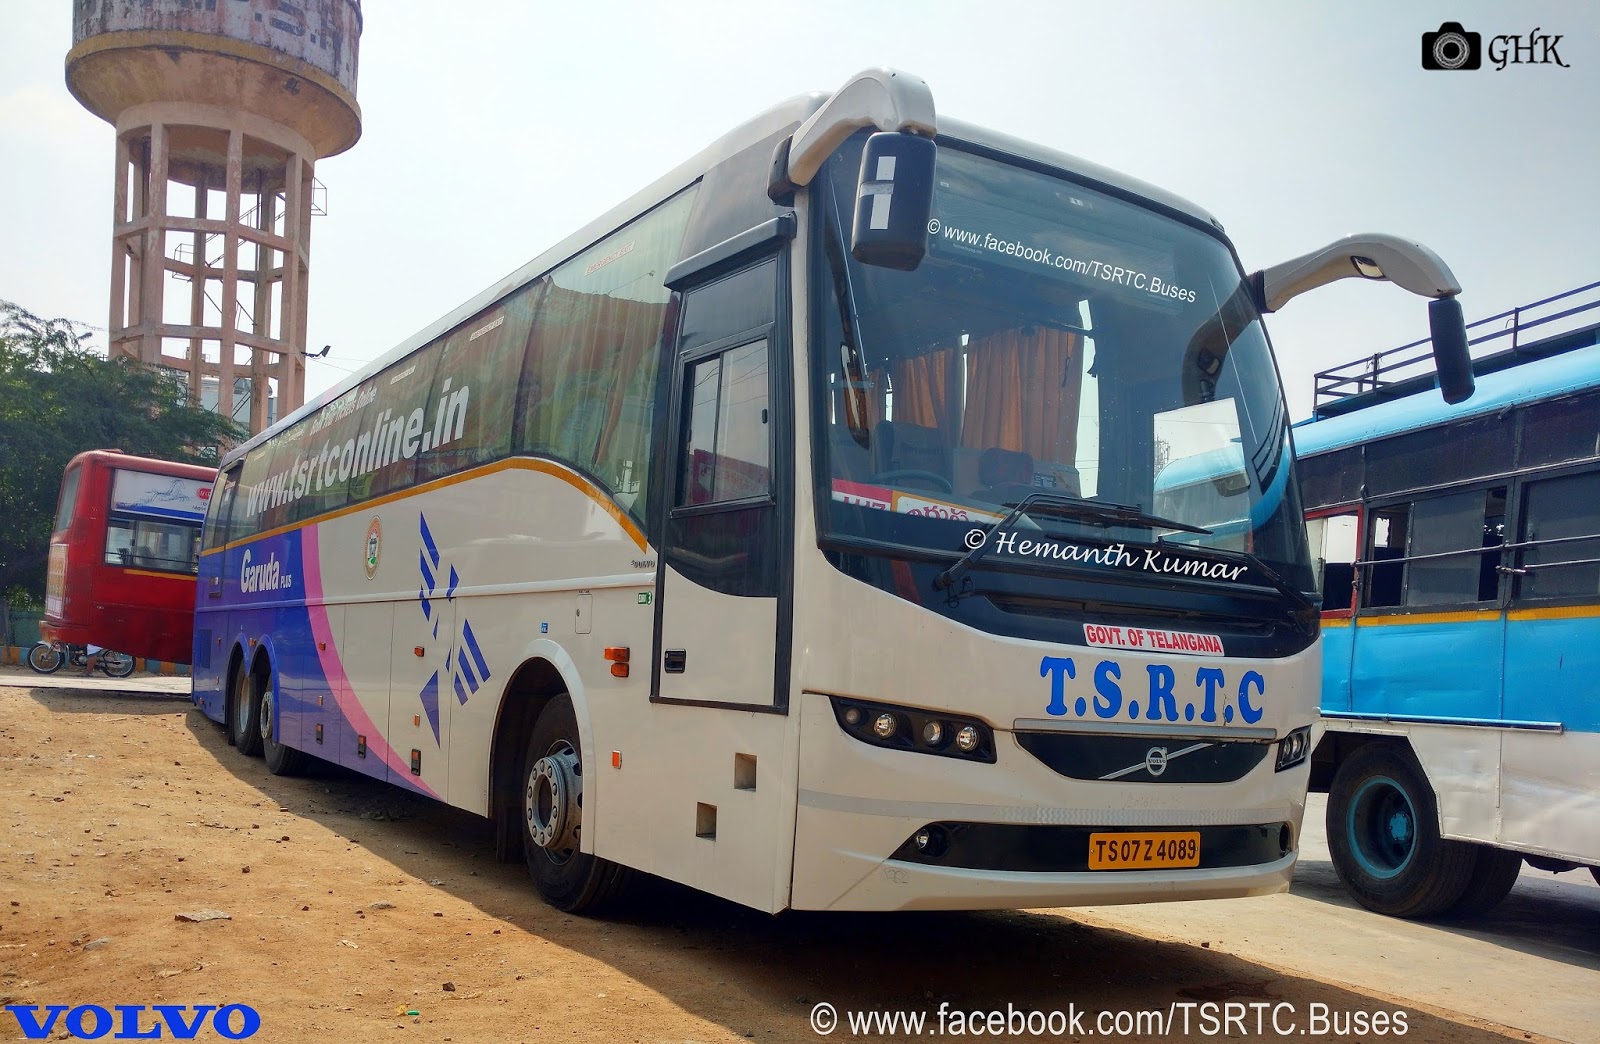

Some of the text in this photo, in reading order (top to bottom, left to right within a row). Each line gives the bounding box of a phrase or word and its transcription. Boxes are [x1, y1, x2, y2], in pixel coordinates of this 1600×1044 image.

[246, 375, 470, 519] www.tsrtconline.in
[240, 548, 292, 594] Garuda PLUS
[1085, 624, 1223, 654] GOVT. OF TELANGANA
